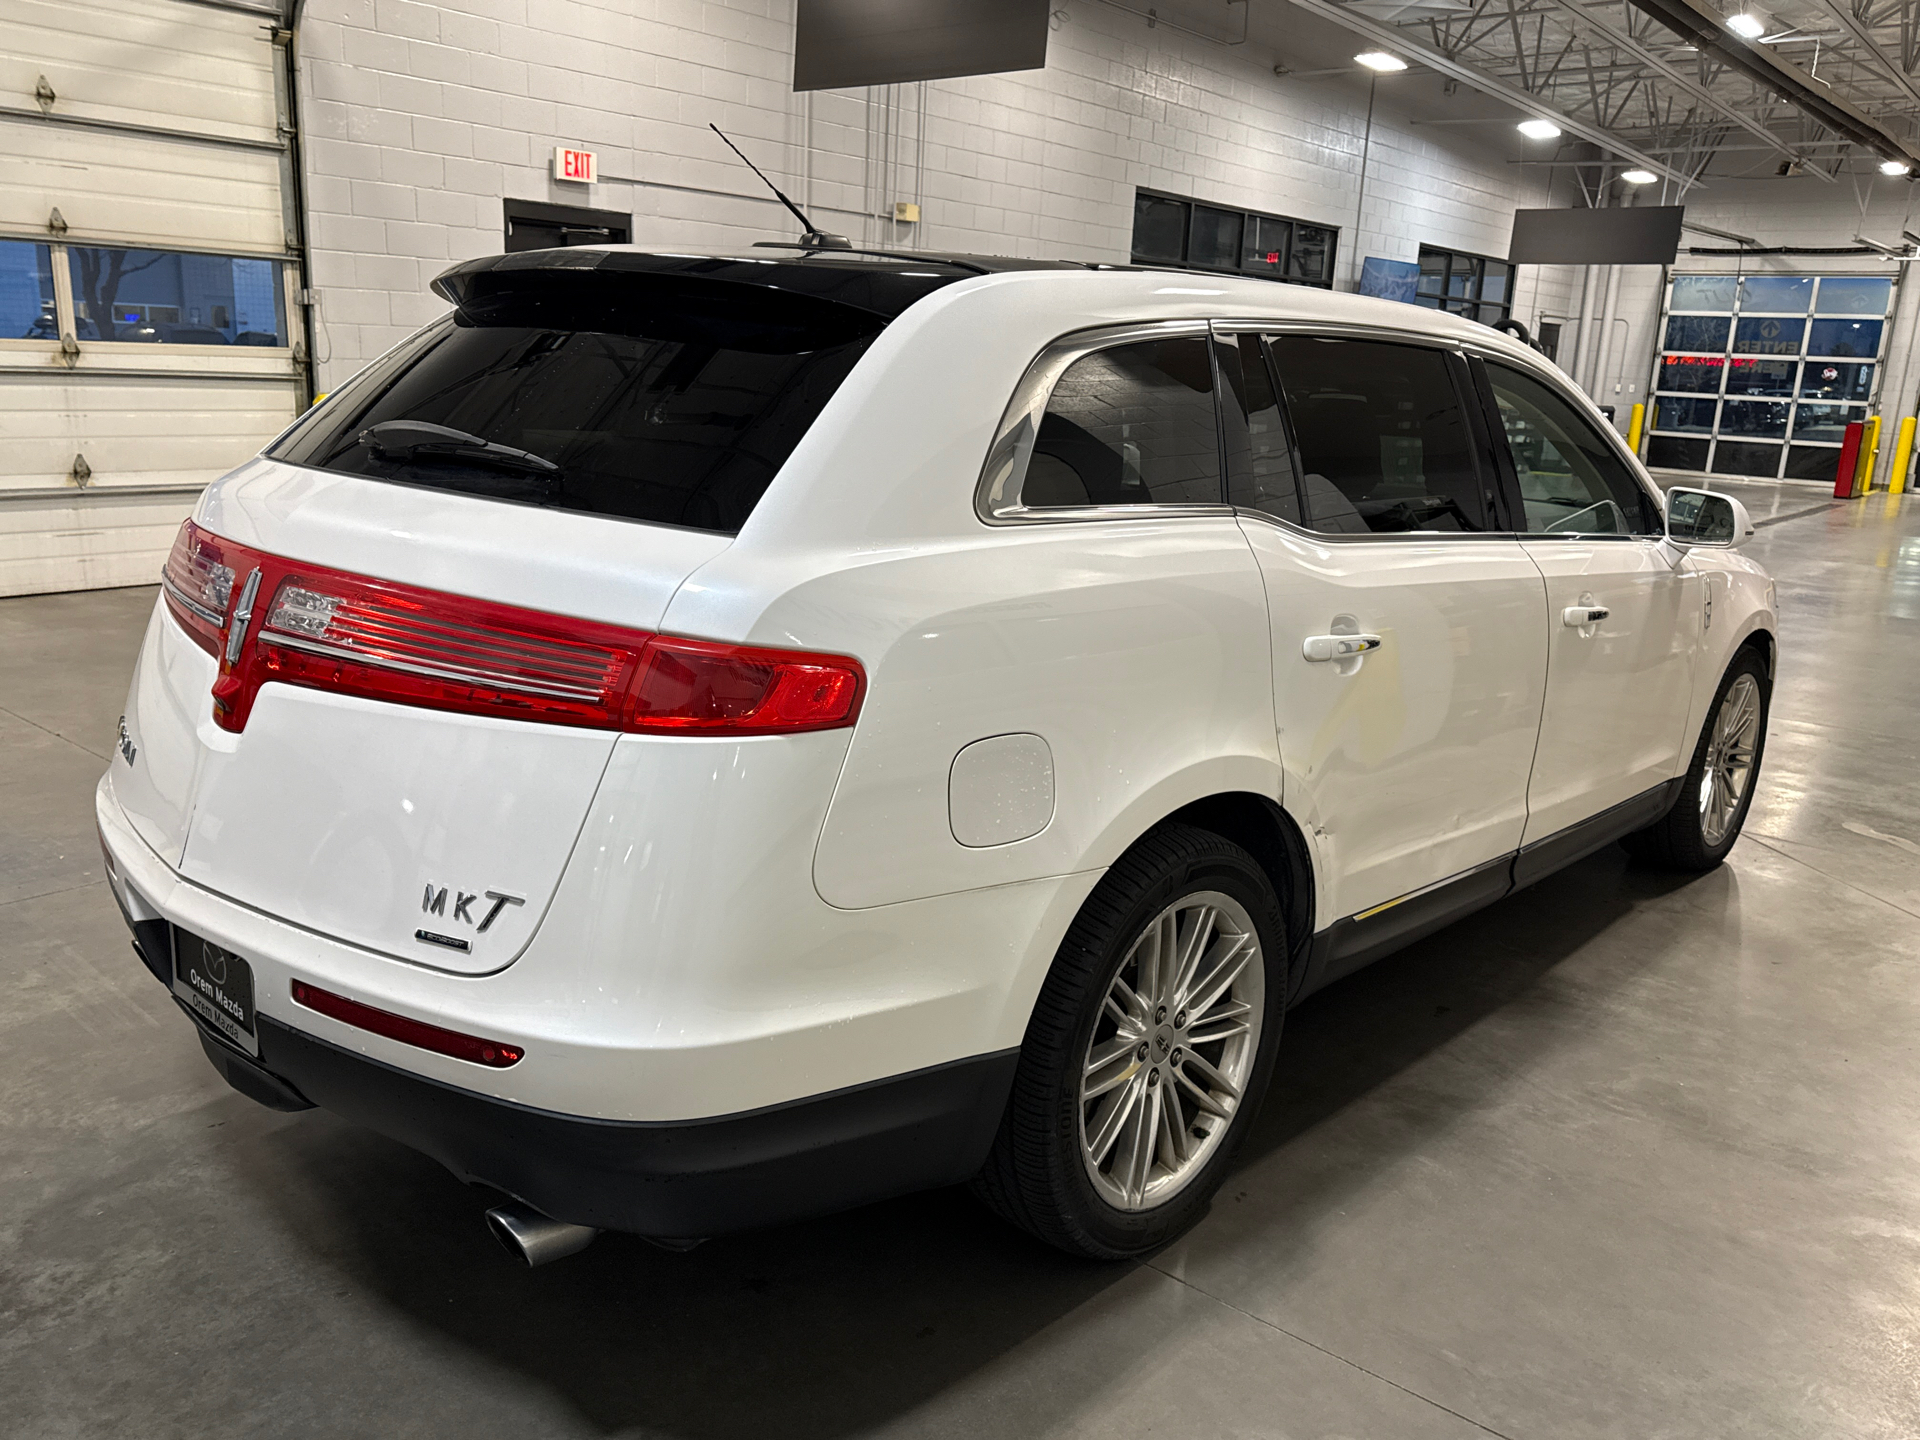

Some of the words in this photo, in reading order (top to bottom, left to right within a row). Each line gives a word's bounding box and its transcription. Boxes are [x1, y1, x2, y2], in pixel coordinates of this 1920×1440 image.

[564, 150, 592, 179] EXIT
[190, 968, 214, 996] Orem
[215, 986, 244, 1021] Mazda
[192, 994, 213, 1019] Orem
[214, 1011, 239, 1039] Mazda
